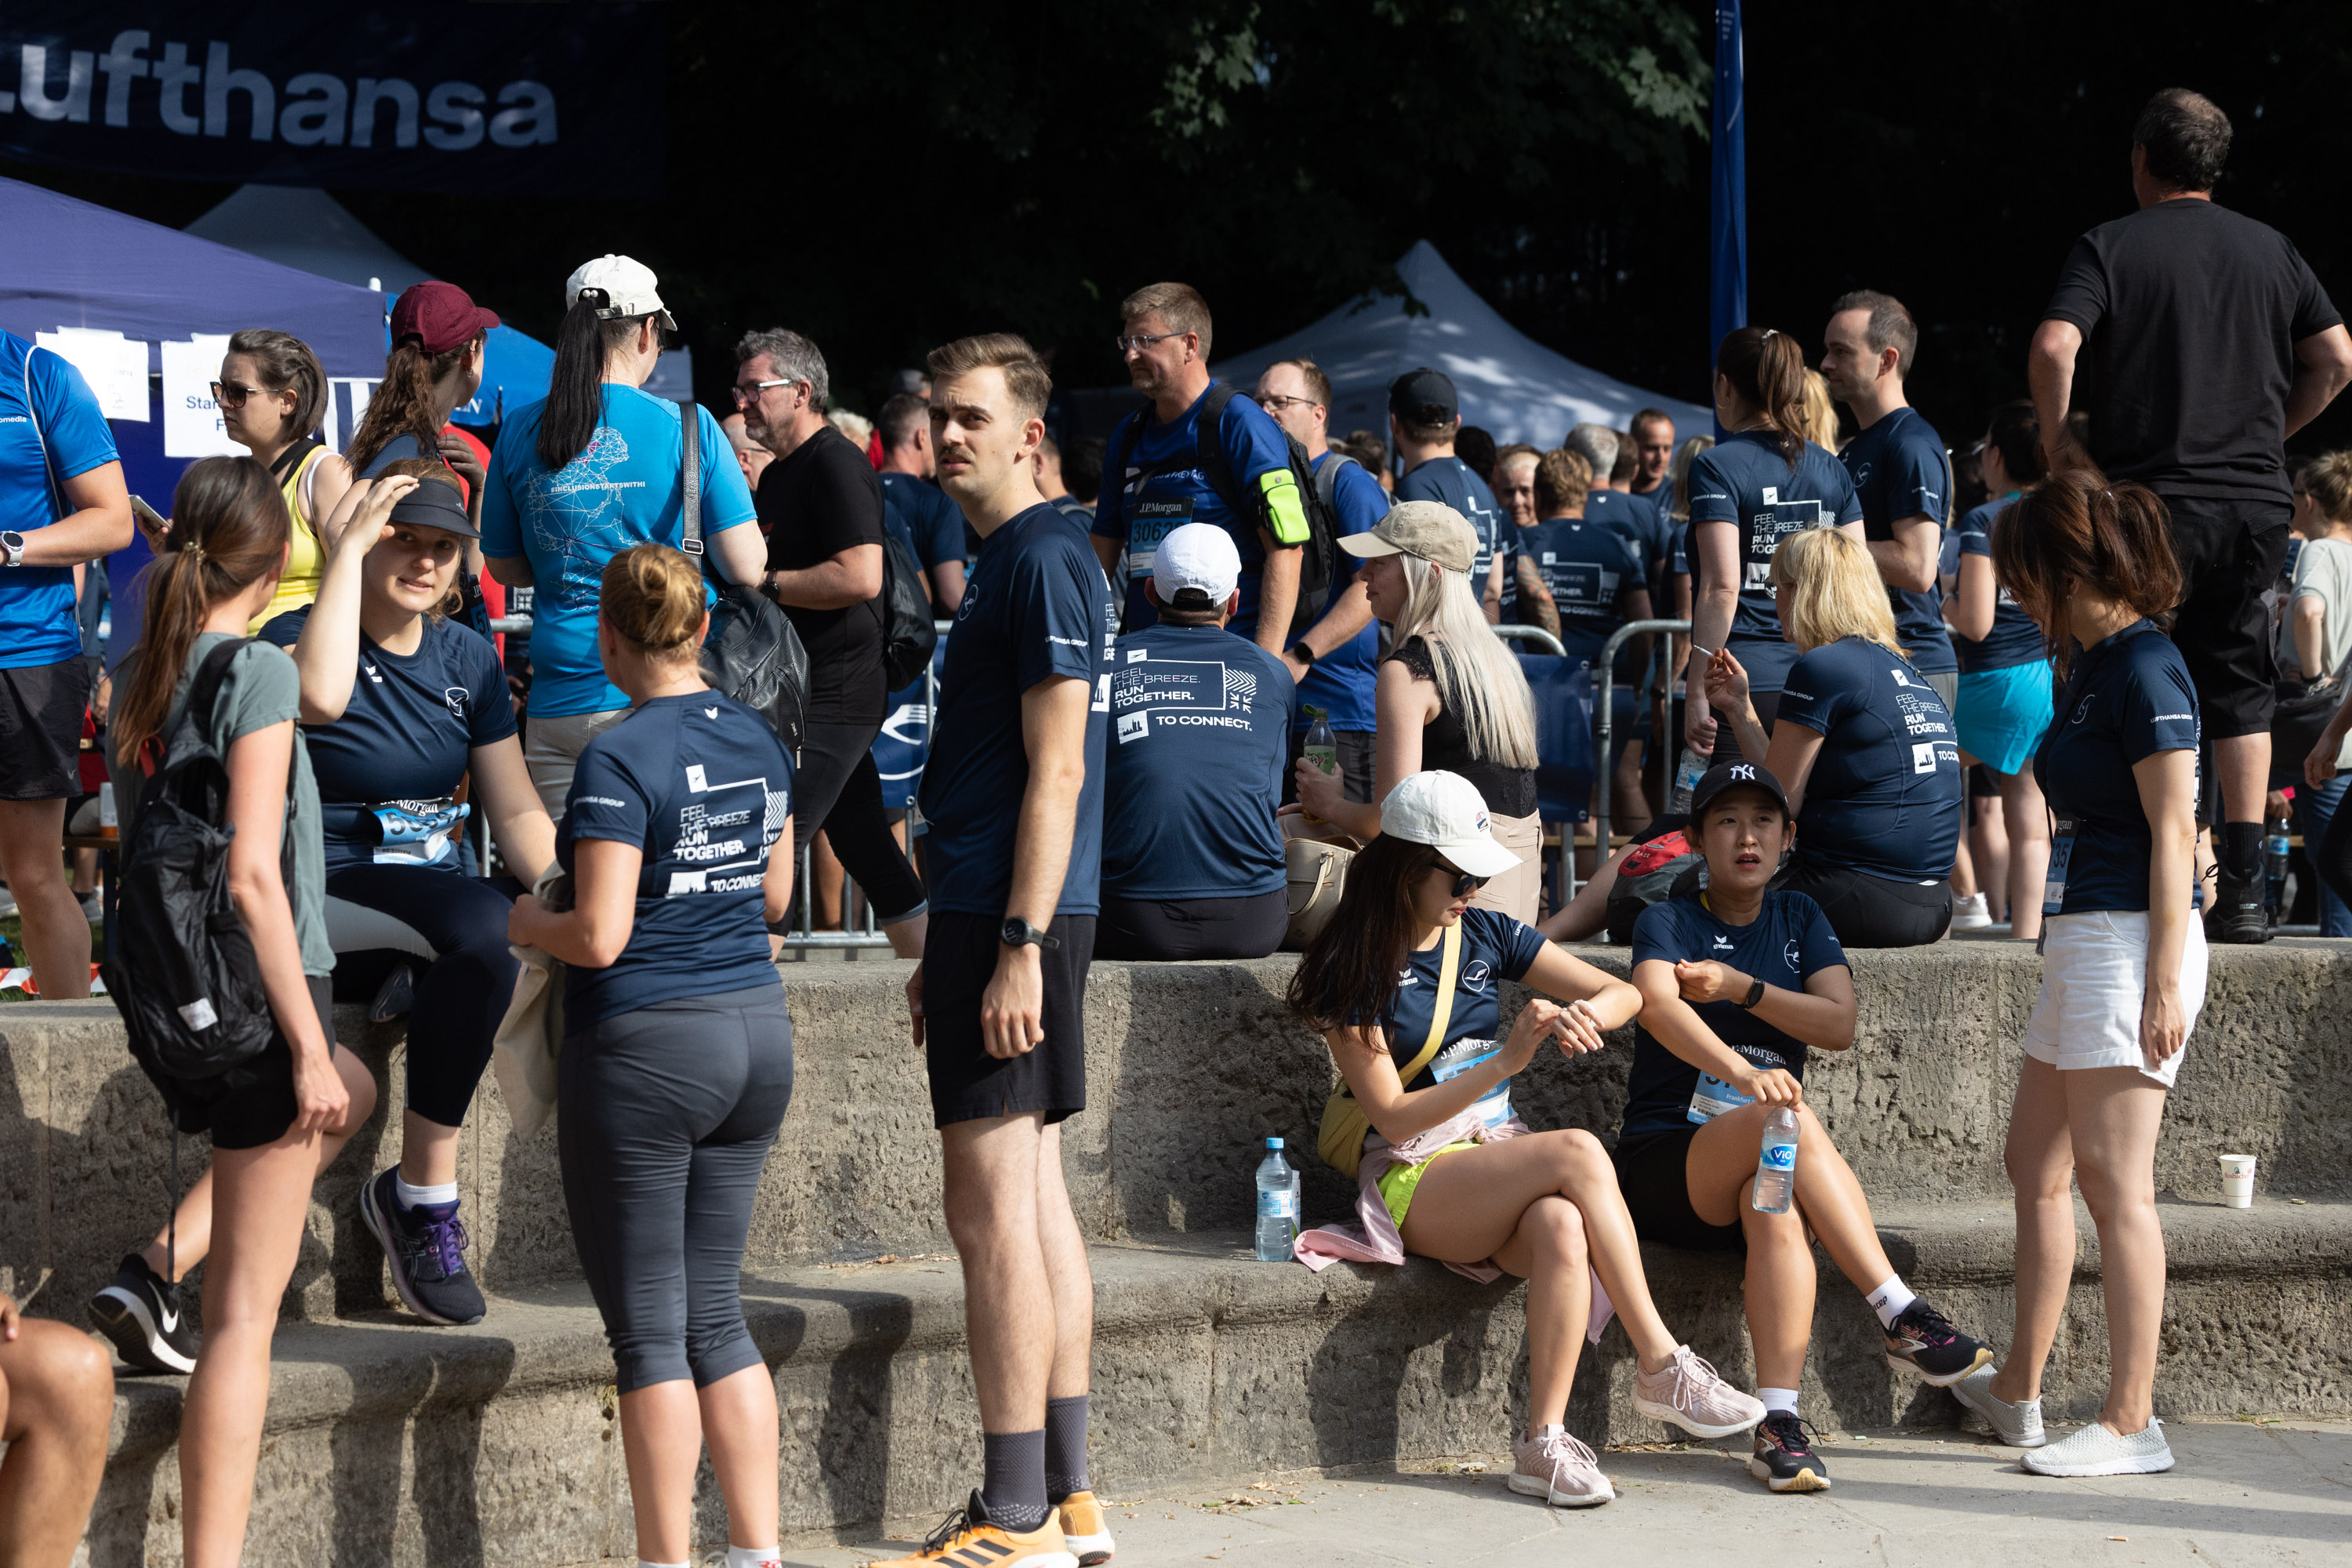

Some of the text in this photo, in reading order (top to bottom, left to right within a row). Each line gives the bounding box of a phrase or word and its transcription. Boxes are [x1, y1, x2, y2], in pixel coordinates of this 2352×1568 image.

[550, 481, 645, 493] #INCLUSIONSTARTSWITHI
[1139, 503, 1181, 515] J.P.Morgan
[1754, 514, 1777, 524] FEEL
[1133, 521, 1185, 543] 3062
[1754, 521, 1804, 535] THE BREEZE
[1752, 534, 1775, 544] RUN
[1751, 543, 1779, 554] TOGE
[1114, 667, 1147, 682] FEEL
[1114, 673, 1201, 690] THE BREEZE.
[1115, 685, 1144, 700] RUN
[1796, 692, 1814, 701] GROUP
[1115, 691, 1195, 709] TOGETHER.
[1896, 693, 1919, 705] FEEL
[1900, 702, 1921, 714] THE
[1156, 716, 1253, 731] TO CONNECT.
[1904, 713, 1926, 725] RUN
[2151, 713, 2181, 723] LUFTHANSA
[1907, 723, 1948, 735] TOGETHER.
[1936, 751, 1947, 760] TO
[598, 797, 626, 808] GROUP
[680, 804, 710, 823] FEEL
[673, 839, 747, 861] TOGETHER.
[710, 879, 727, 893] TO
[1726, 1094, 1751, 1105] Frankfurt
